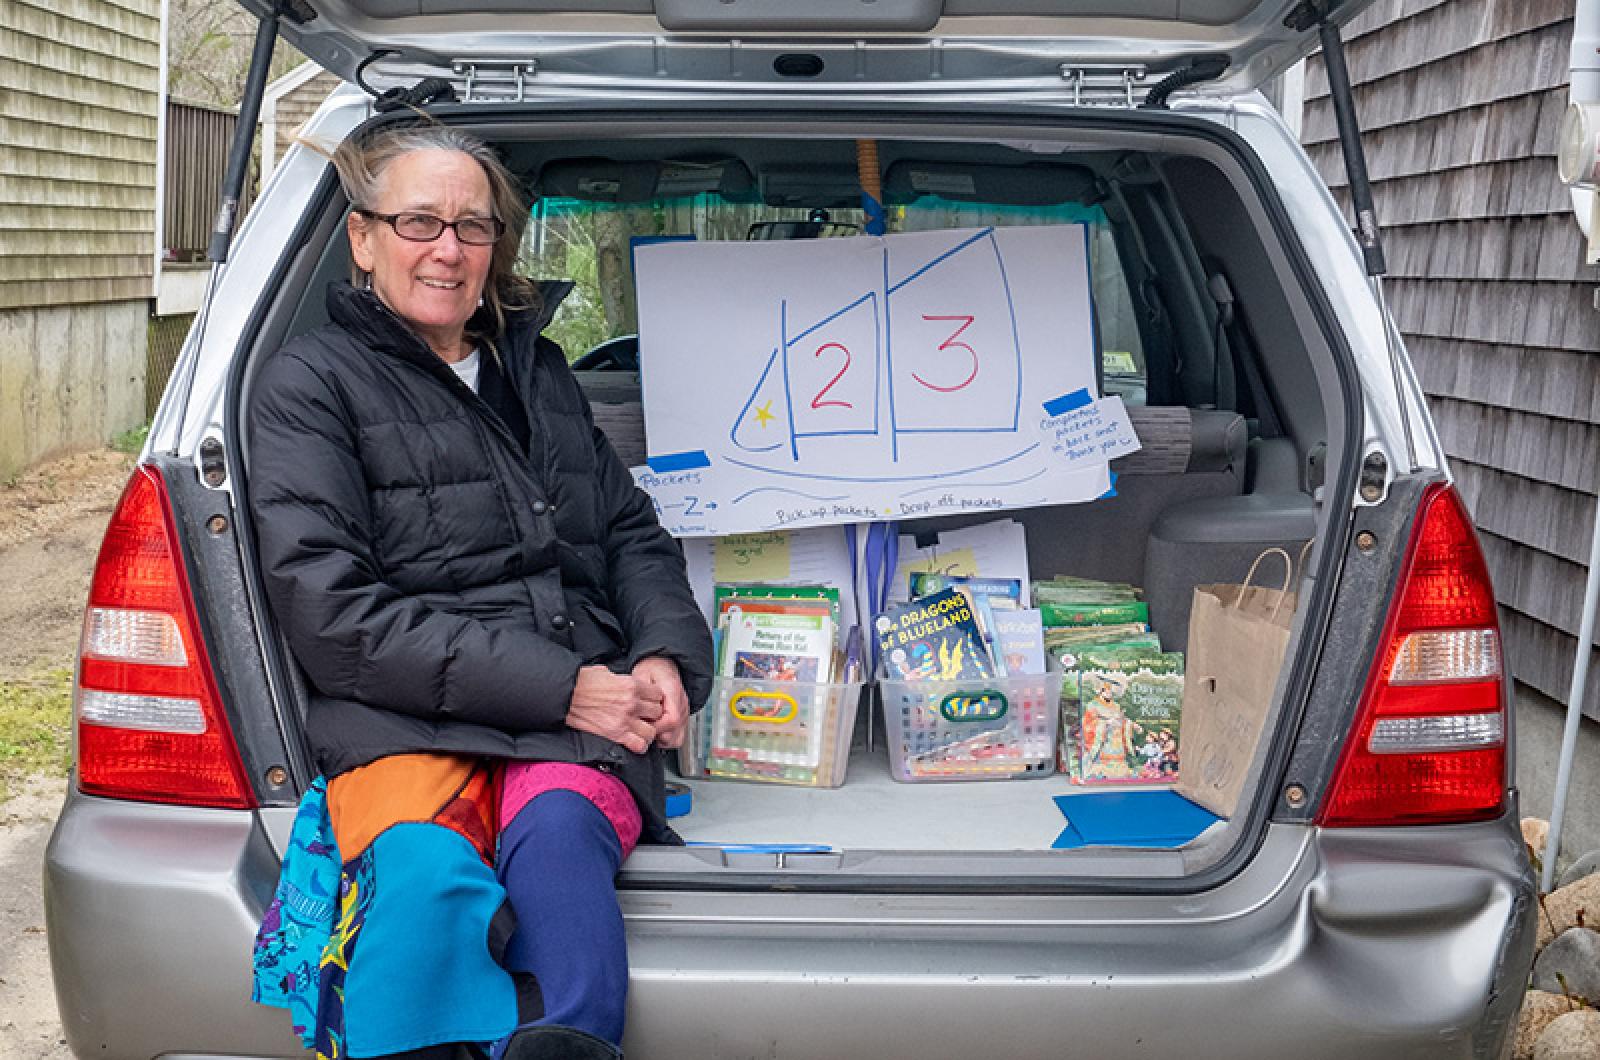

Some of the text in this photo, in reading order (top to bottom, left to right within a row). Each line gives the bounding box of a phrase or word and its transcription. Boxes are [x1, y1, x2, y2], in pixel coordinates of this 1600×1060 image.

[911, 314, 979, 393] 3
[812, 341, 852, 410] 2
[638, 472, 702, 488] Packets
[775, 508, 806, 524] Pick
[809, 507, 827, 519] up
[898, 607, 971, 645] BLUELAND
[901, 593, 965, 627] DRAGONS
